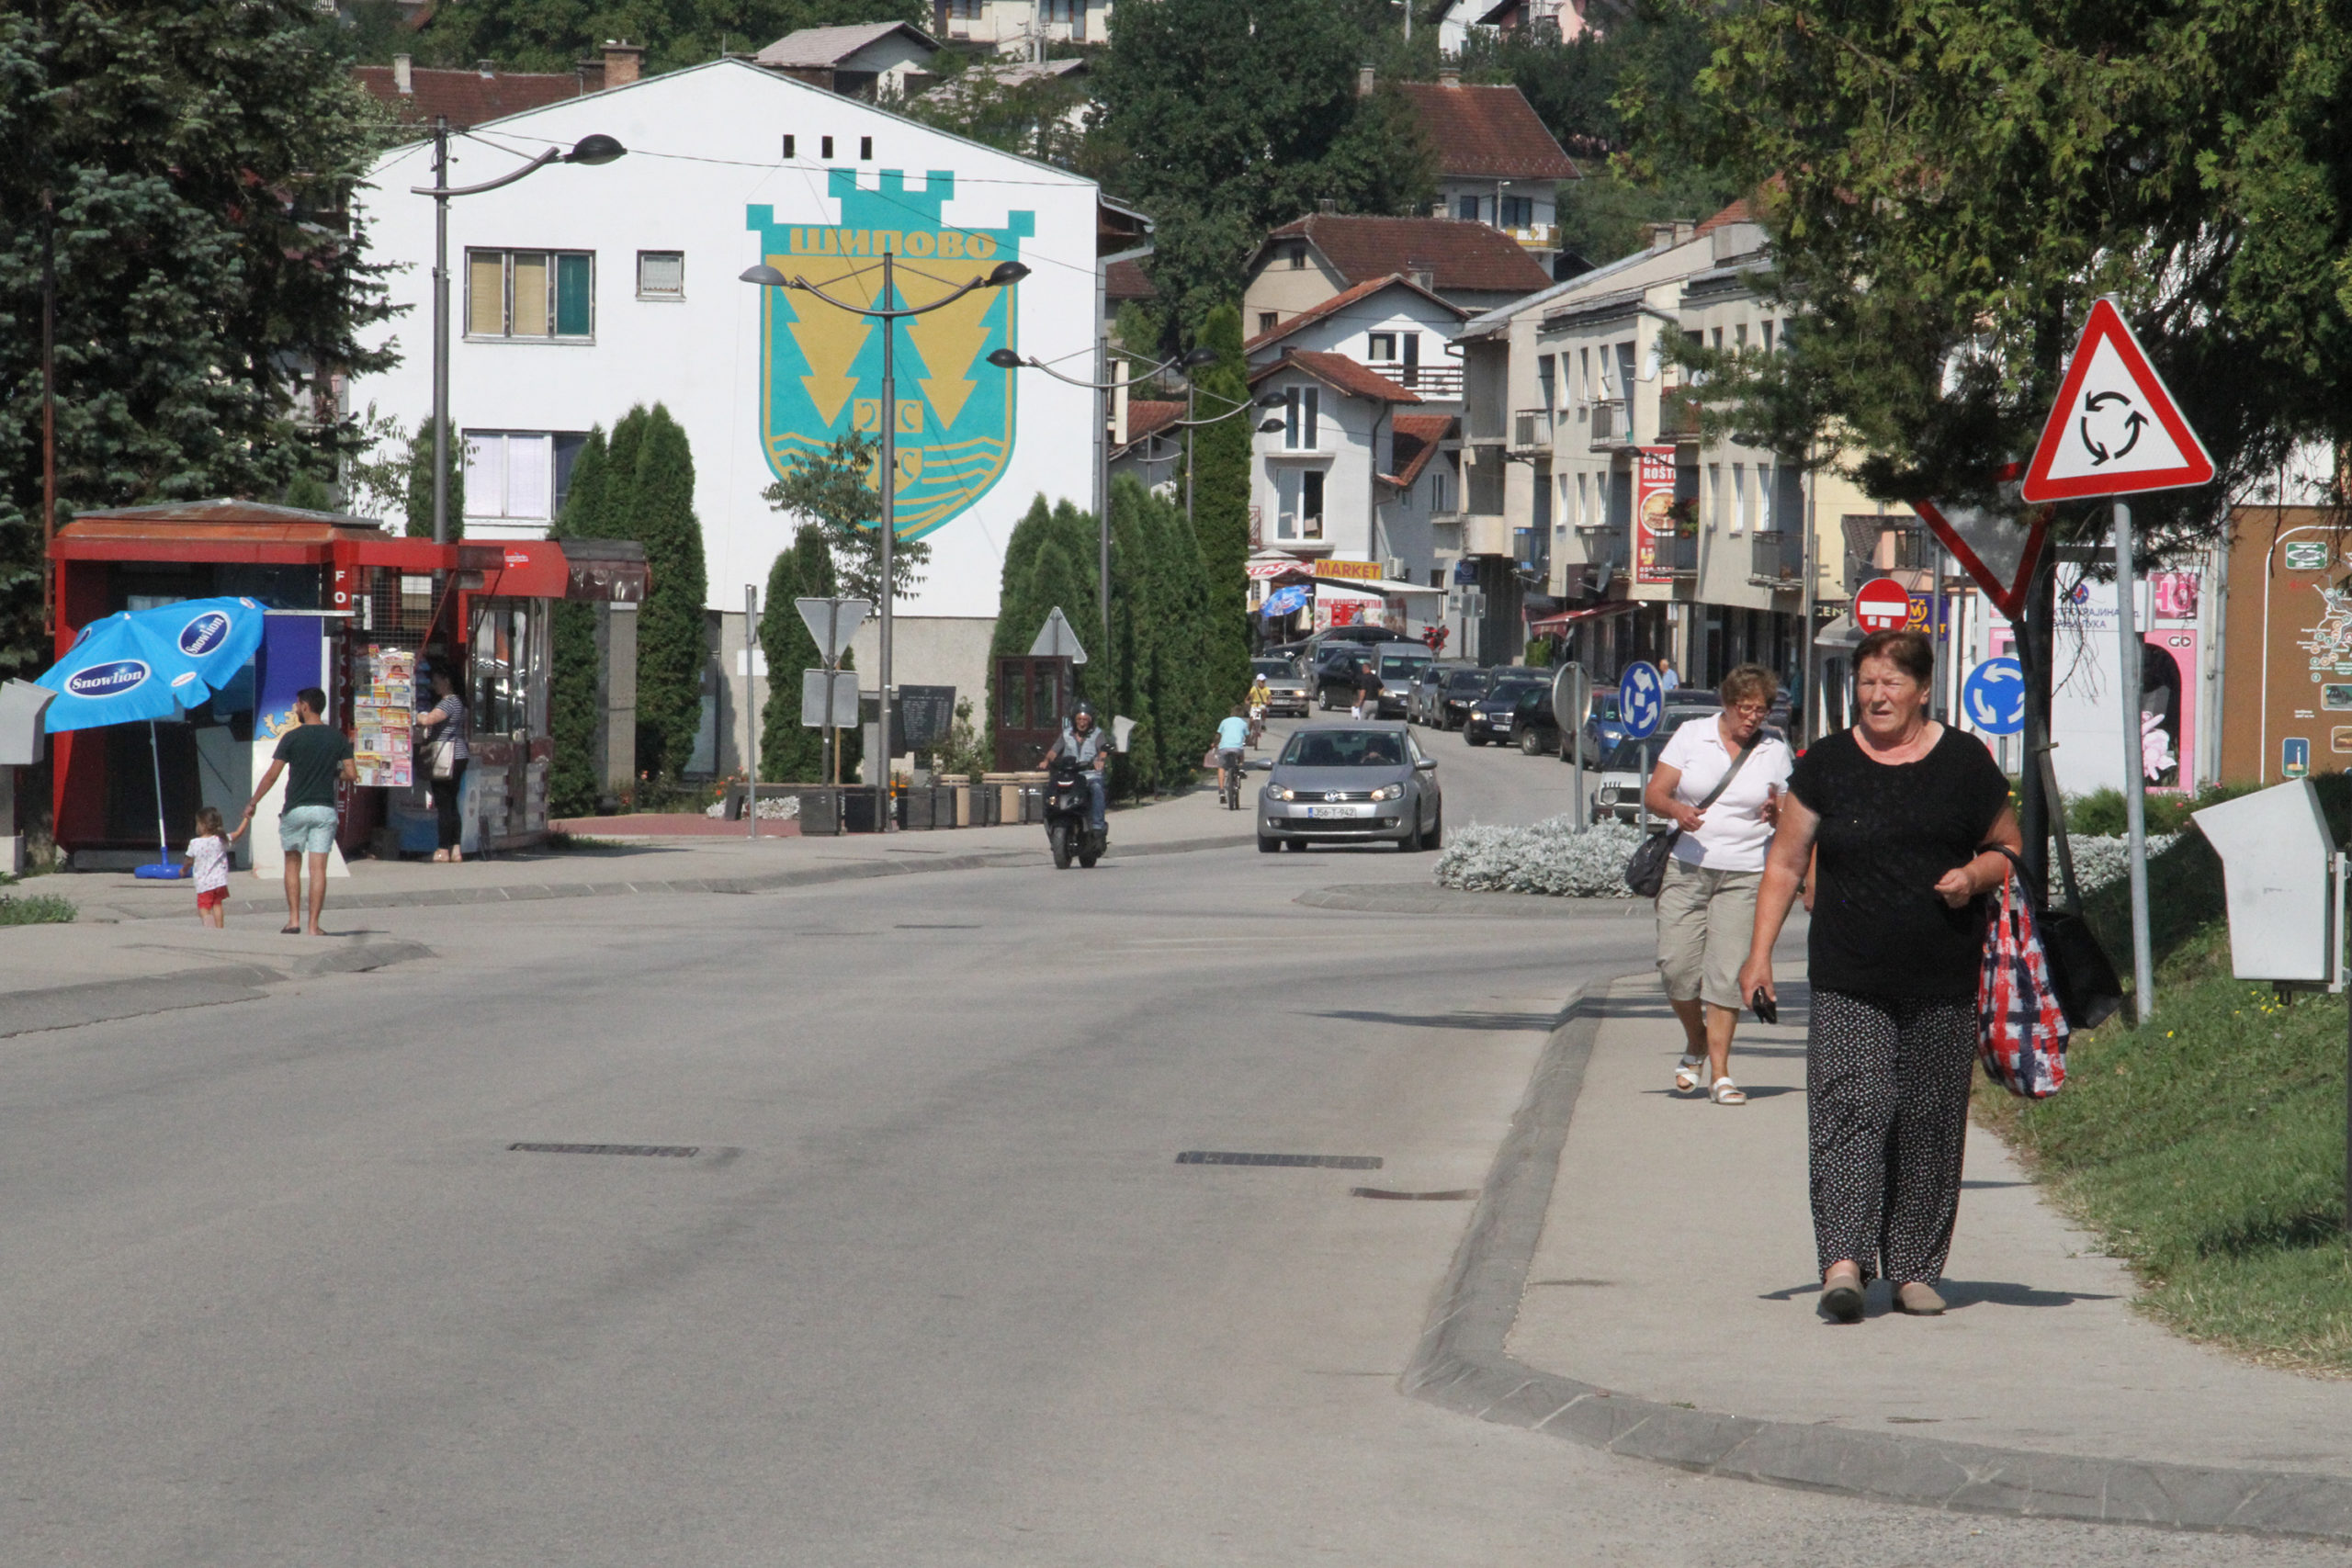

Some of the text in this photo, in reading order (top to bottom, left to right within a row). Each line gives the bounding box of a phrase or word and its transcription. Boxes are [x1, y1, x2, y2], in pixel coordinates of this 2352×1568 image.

[789, 228, 997, 258] ШИПОВО
[1317, 562, 1380, 579] MARKET
[185, 616, 225, 655] Snowlion
[71, 669, 142, 691] Snowlion
